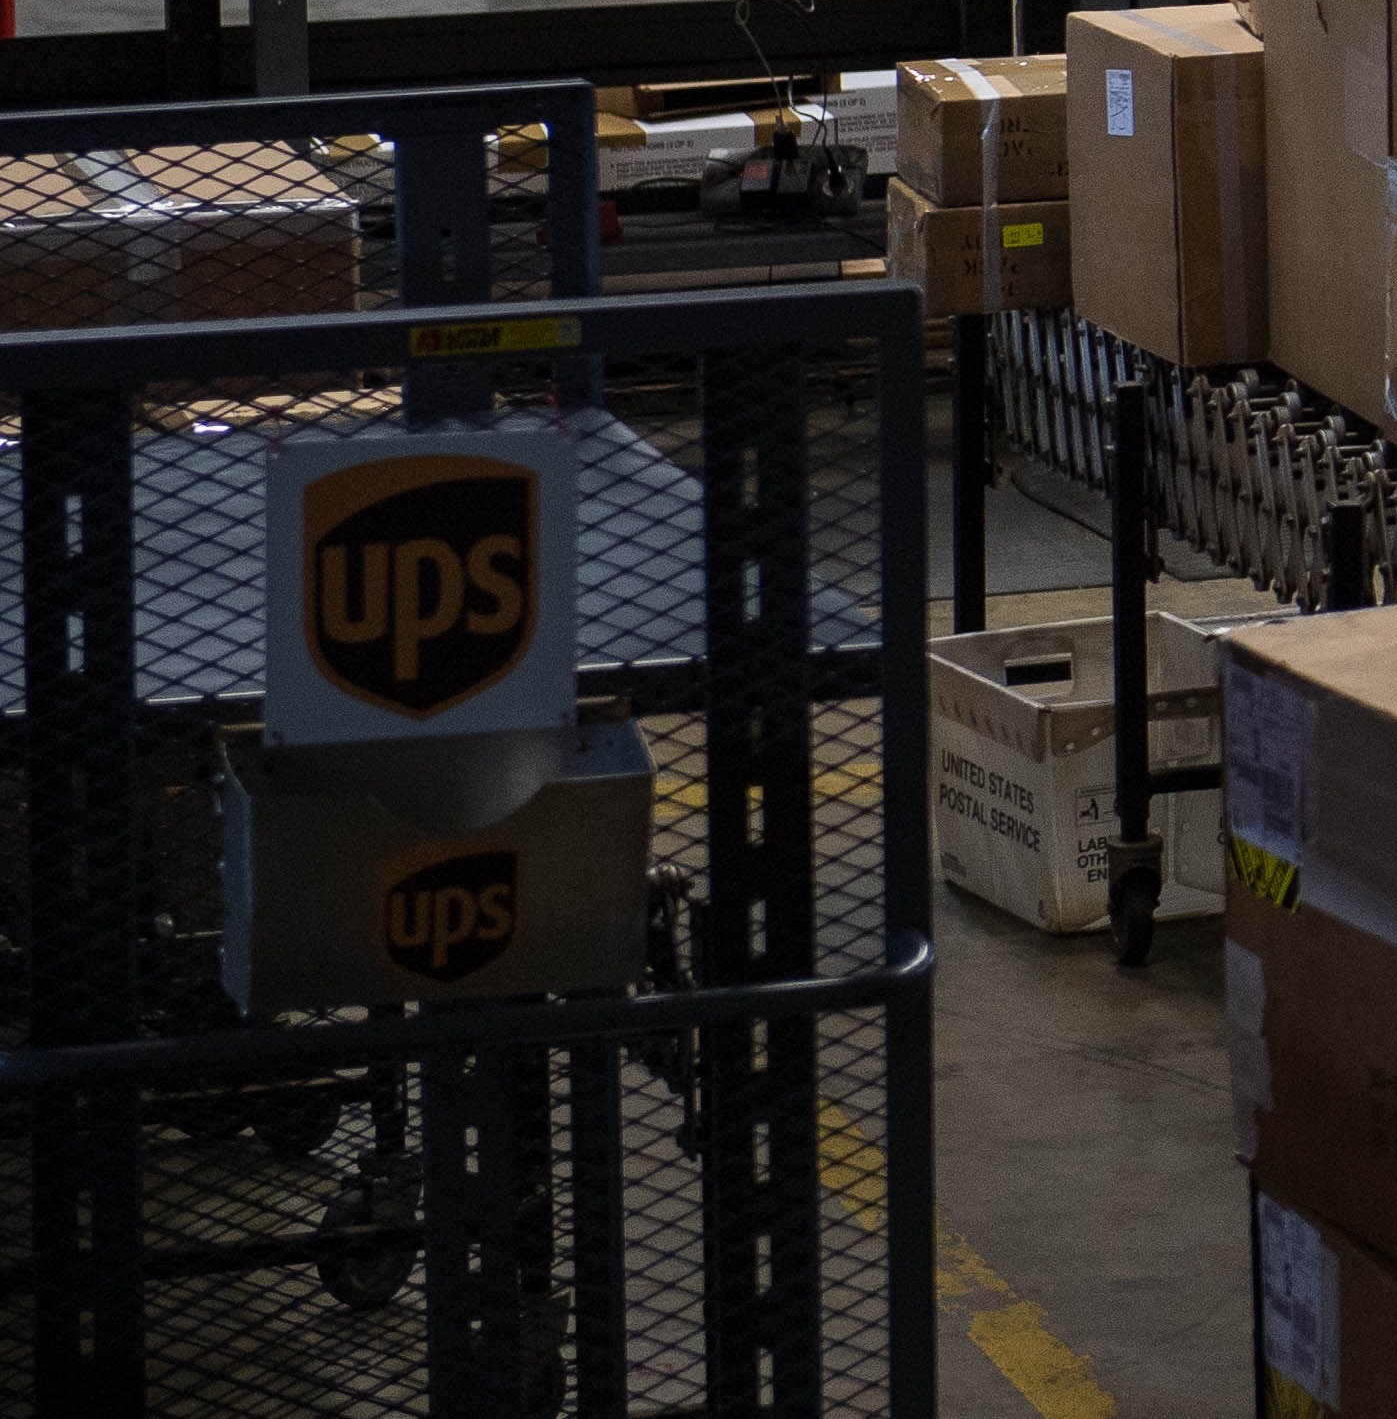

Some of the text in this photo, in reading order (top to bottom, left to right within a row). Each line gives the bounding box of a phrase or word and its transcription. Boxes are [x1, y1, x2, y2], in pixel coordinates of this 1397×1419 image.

[320, 534, 525, 681] ups
[941, 751, 1034, 814] UNITED STATES
[940, 784, 1041, 853] POSTAL SERVICE
[1077, 853, 1110, 869] OTH
[389, 882, 514, 969] ups
